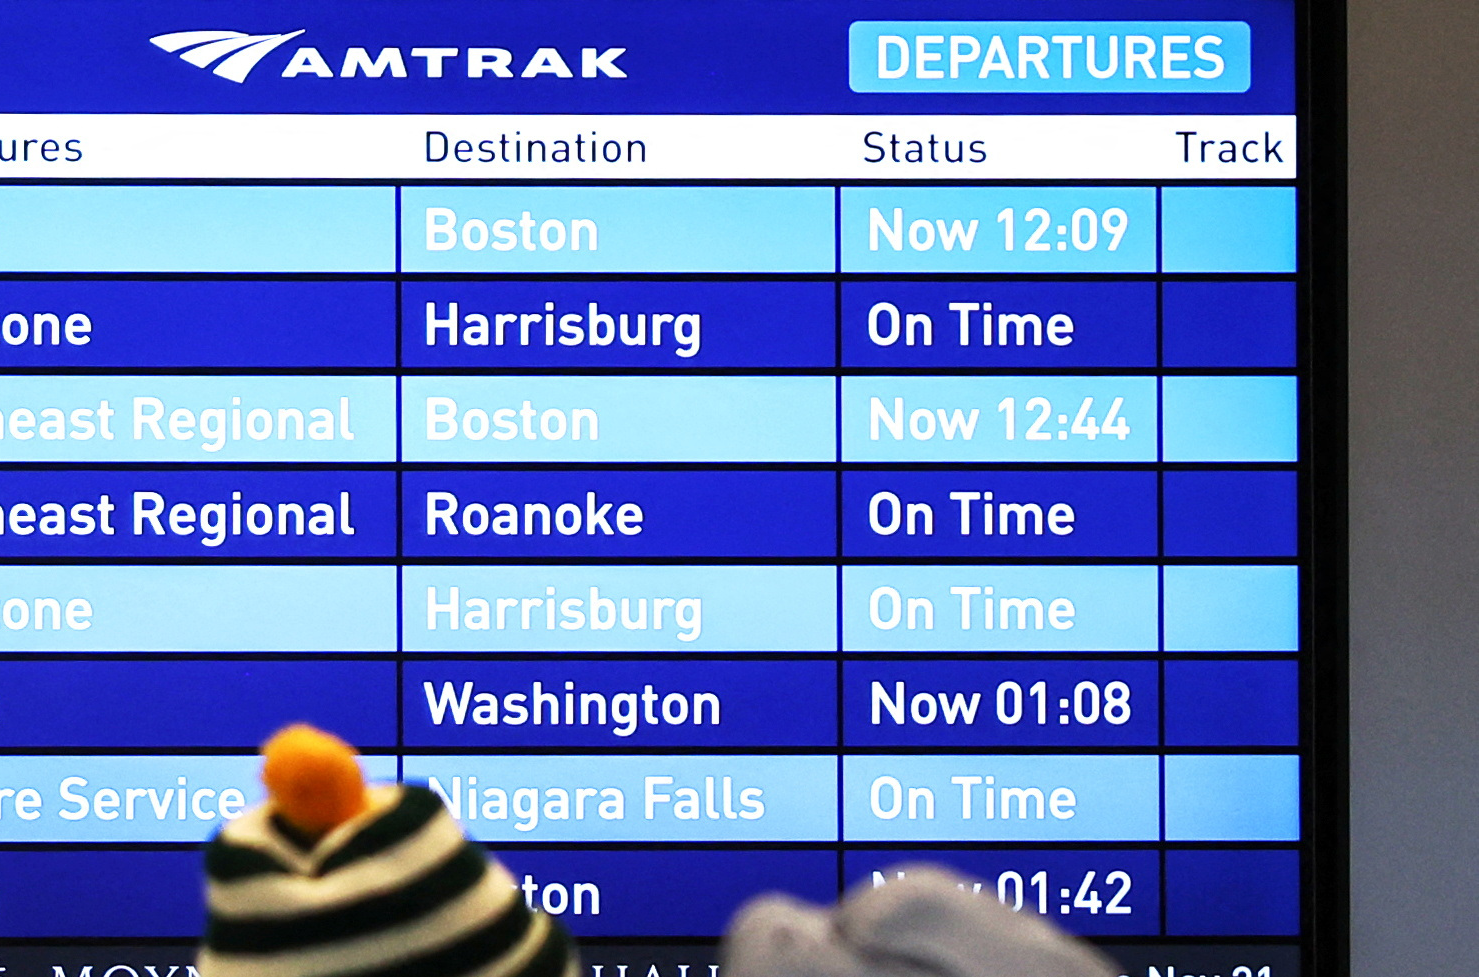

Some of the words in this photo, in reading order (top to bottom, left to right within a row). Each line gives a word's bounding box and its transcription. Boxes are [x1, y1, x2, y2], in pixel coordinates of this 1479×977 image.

[281, 47, 628, 79] AMTRAK
[878, 35, 1225, 79] DEPARTURES
[426, 130, 646, 163] Destination
[863, 131, 987, 164] Status
[1175, 131, 1284, 164] Track
[426, 207, 598, 252] Boston
[869, 207, 979, 252] Now
[997, 207, 1128, 252] 12:09
[426, 301, 700, 358] Harrisburg
[868, 302, 932, 346] On
[948, 302, 1074, 346] Time
[133, 396, 355, 453] Regional
[426, 396, 598, 441] Boston
[870, 397, 980, 441] Now
[998, 396, 1130, 441] 12:44
[133, 491, 355, 547] Regional
[426, 491, 643, 536] Roanoke
[869, 491, 933, 536] On
[949, 491, 1075, 536] Time
[427, 586, 702, 642] Harrisburg
[869, 586, 934, 630] On
[950, 586, 1075, 630] Time
[423, 681, 720, 737] Washington
[871, 681, 982, 725] Now
[996, 680, 1131, 725] 01:08
[58, 776, 247, 821] Service
[428, 776, 625, 832] Niagara
[644, 776, 765, 820] Falls
[870, 775, 934, 820] On
[951, 775, 1076, 820] Time
[996, 870, 1133, 915] 01:42
